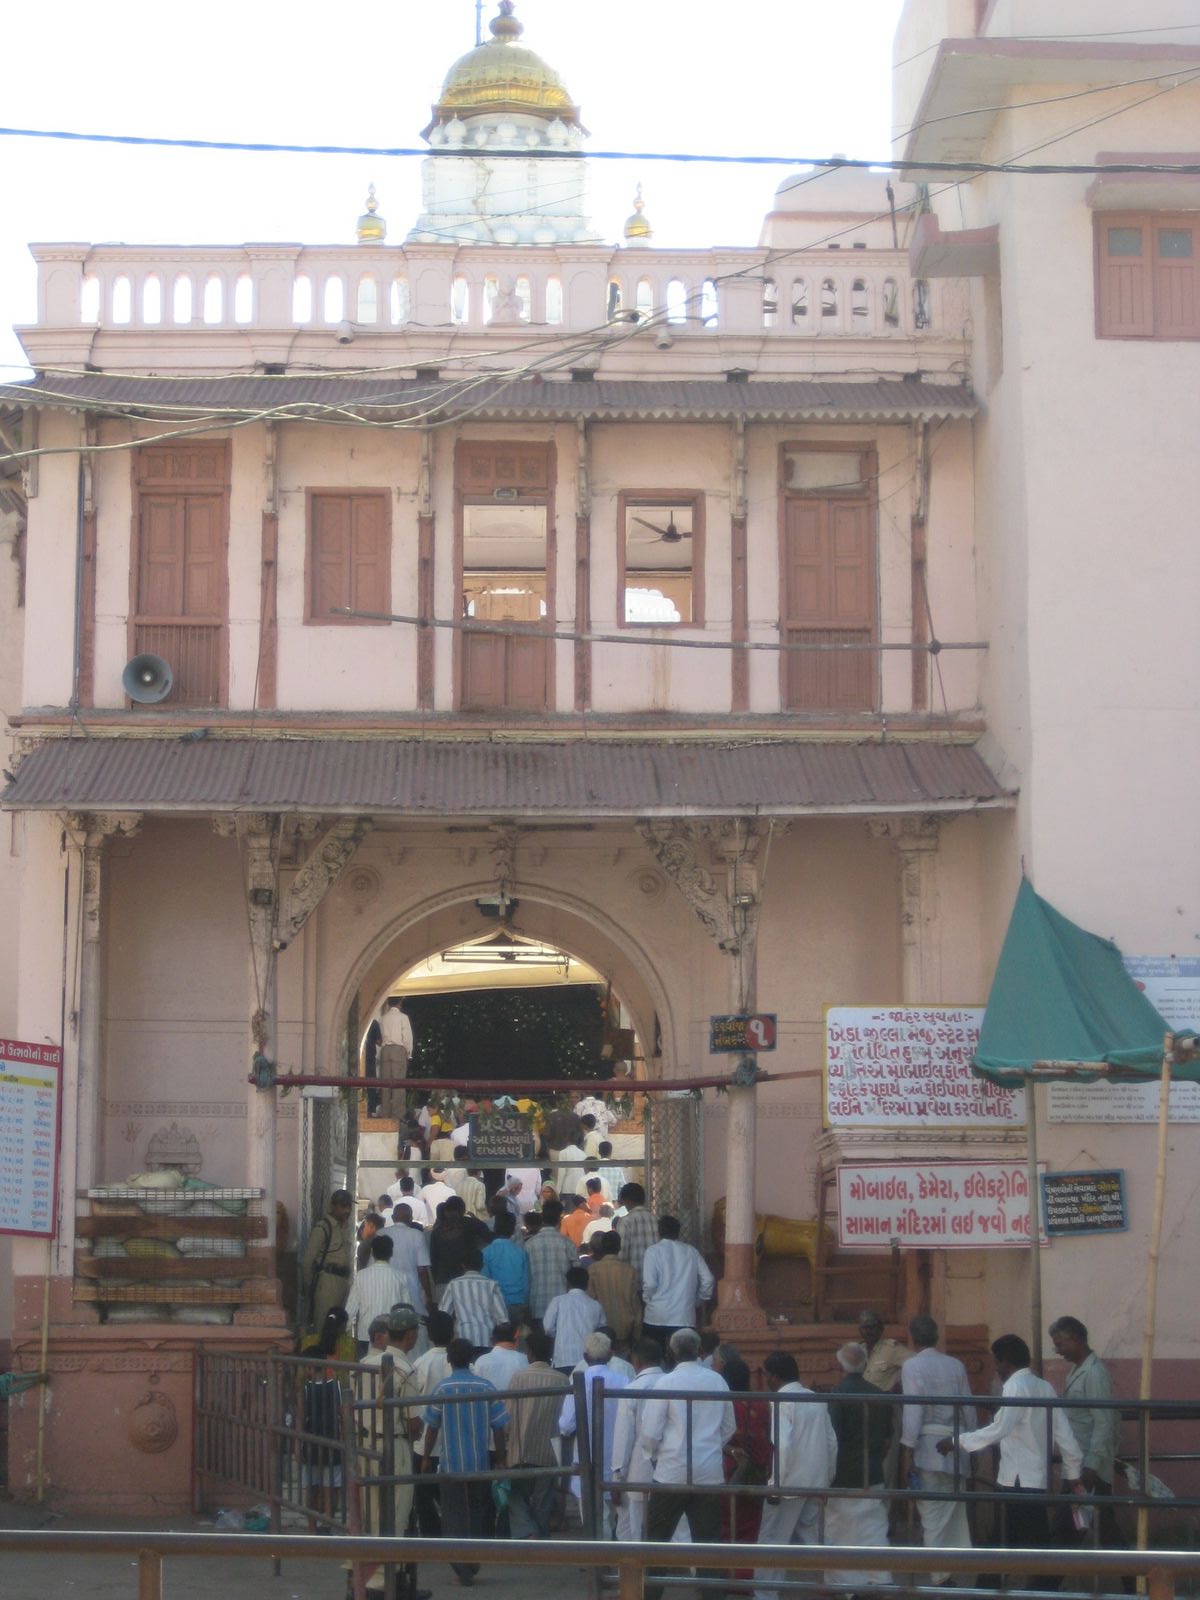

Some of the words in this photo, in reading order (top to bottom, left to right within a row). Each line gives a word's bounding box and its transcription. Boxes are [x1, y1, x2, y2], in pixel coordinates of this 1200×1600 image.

[828, 1022, 862, 1041] ખેડા
[902, 1046, 933, 1063] હુમ
[850, 1174, 914, 1203] મોબાઈલ,
[916, 1171, 960, 1202] કેમેરા,
[964, 1170, 1028, 1204] ઈલેકટ્રોનિ
[846, 1216, 892, 1235] સામાન
[896, 1207, 946, 1235] મંદિરમાં
[951, 1210, 974, 1234] લઈ
[978, 1206, 1006, 1234] જવો
